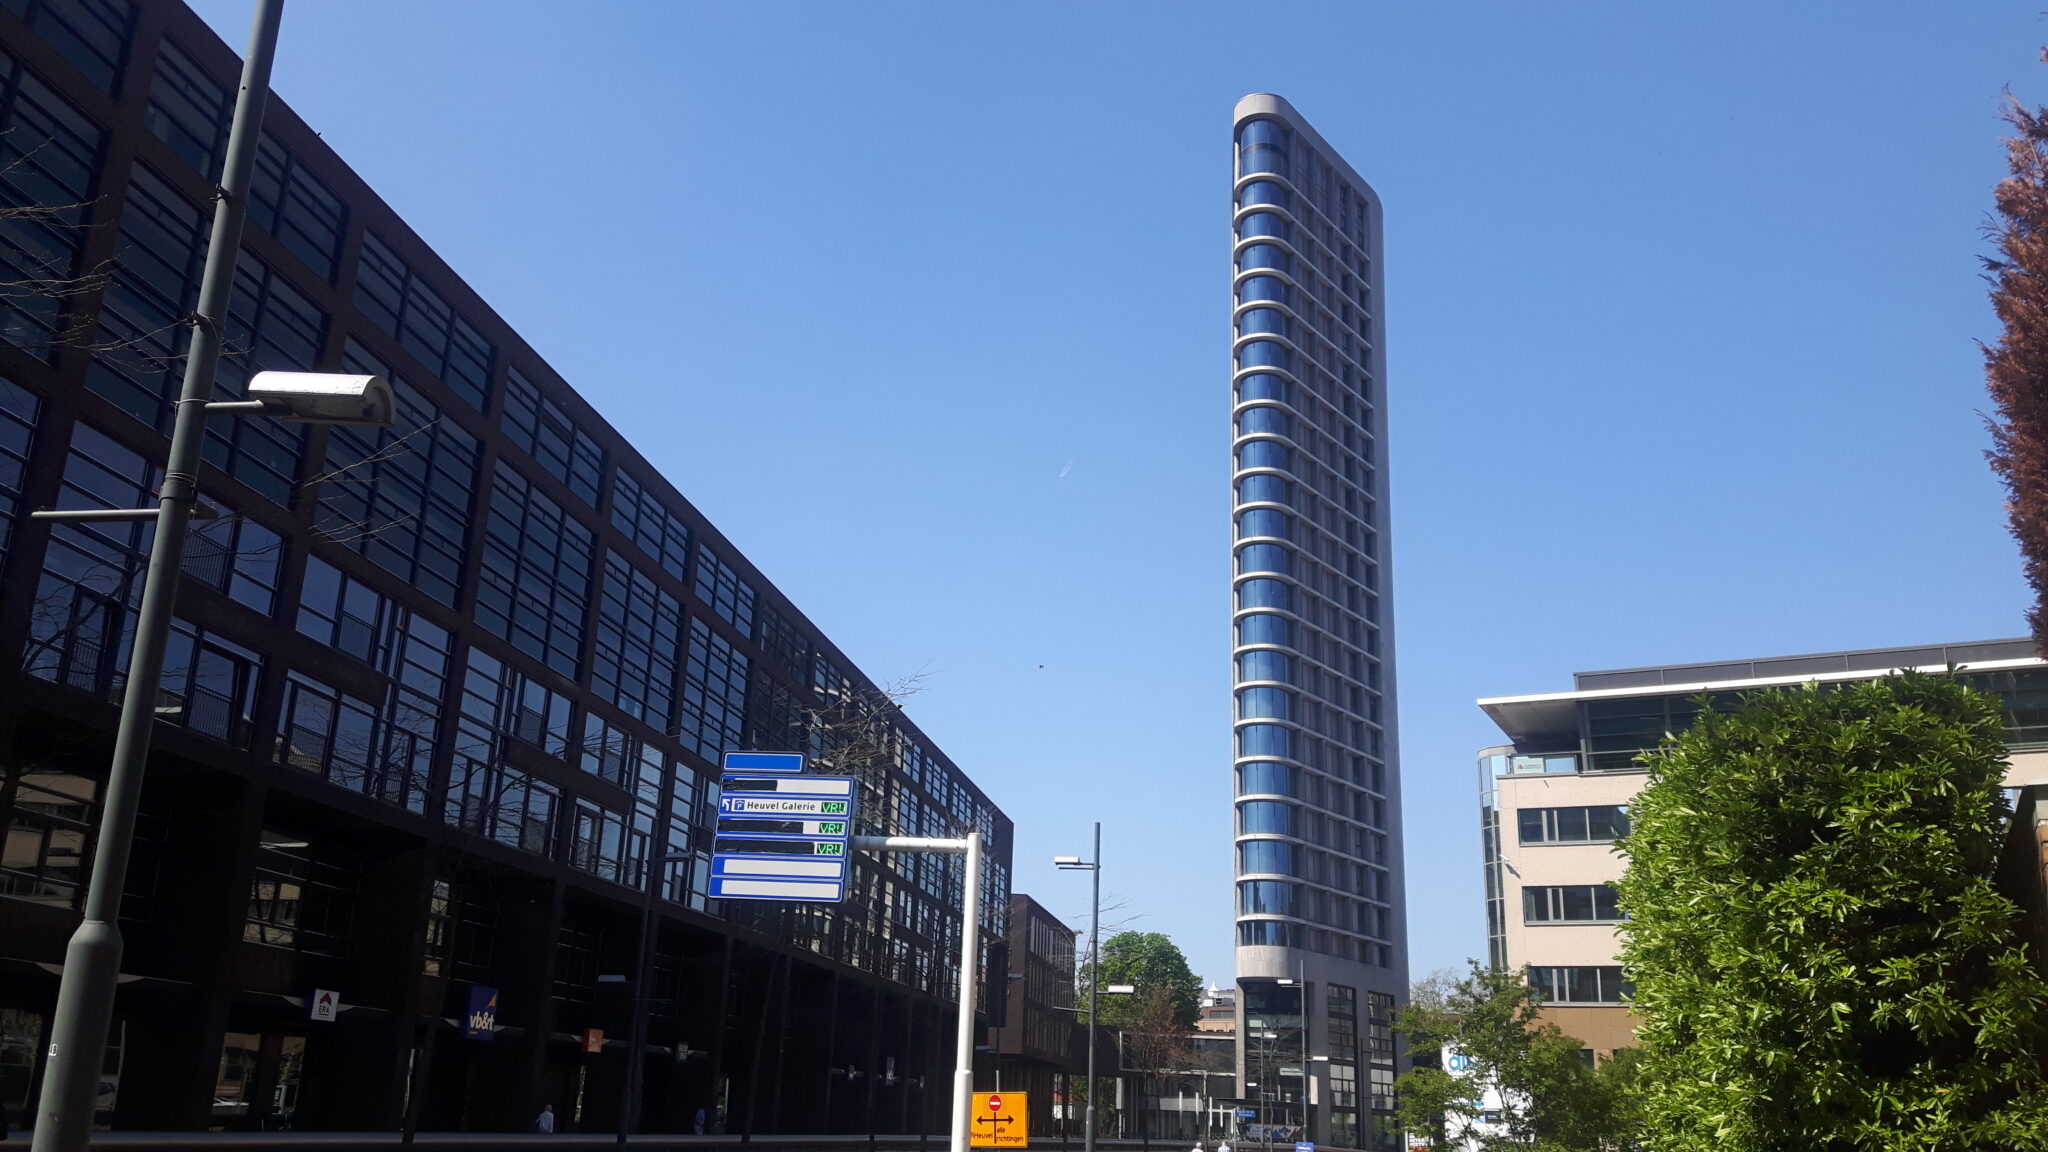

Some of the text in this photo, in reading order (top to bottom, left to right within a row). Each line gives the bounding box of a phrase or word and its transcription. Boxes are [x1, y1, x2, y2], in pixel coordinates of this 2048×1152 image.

[746, 801, 779, 810] Heuvel
[781, 802, 816, 811] Galerie
[469, 1010, 495, 1031] vb&t
